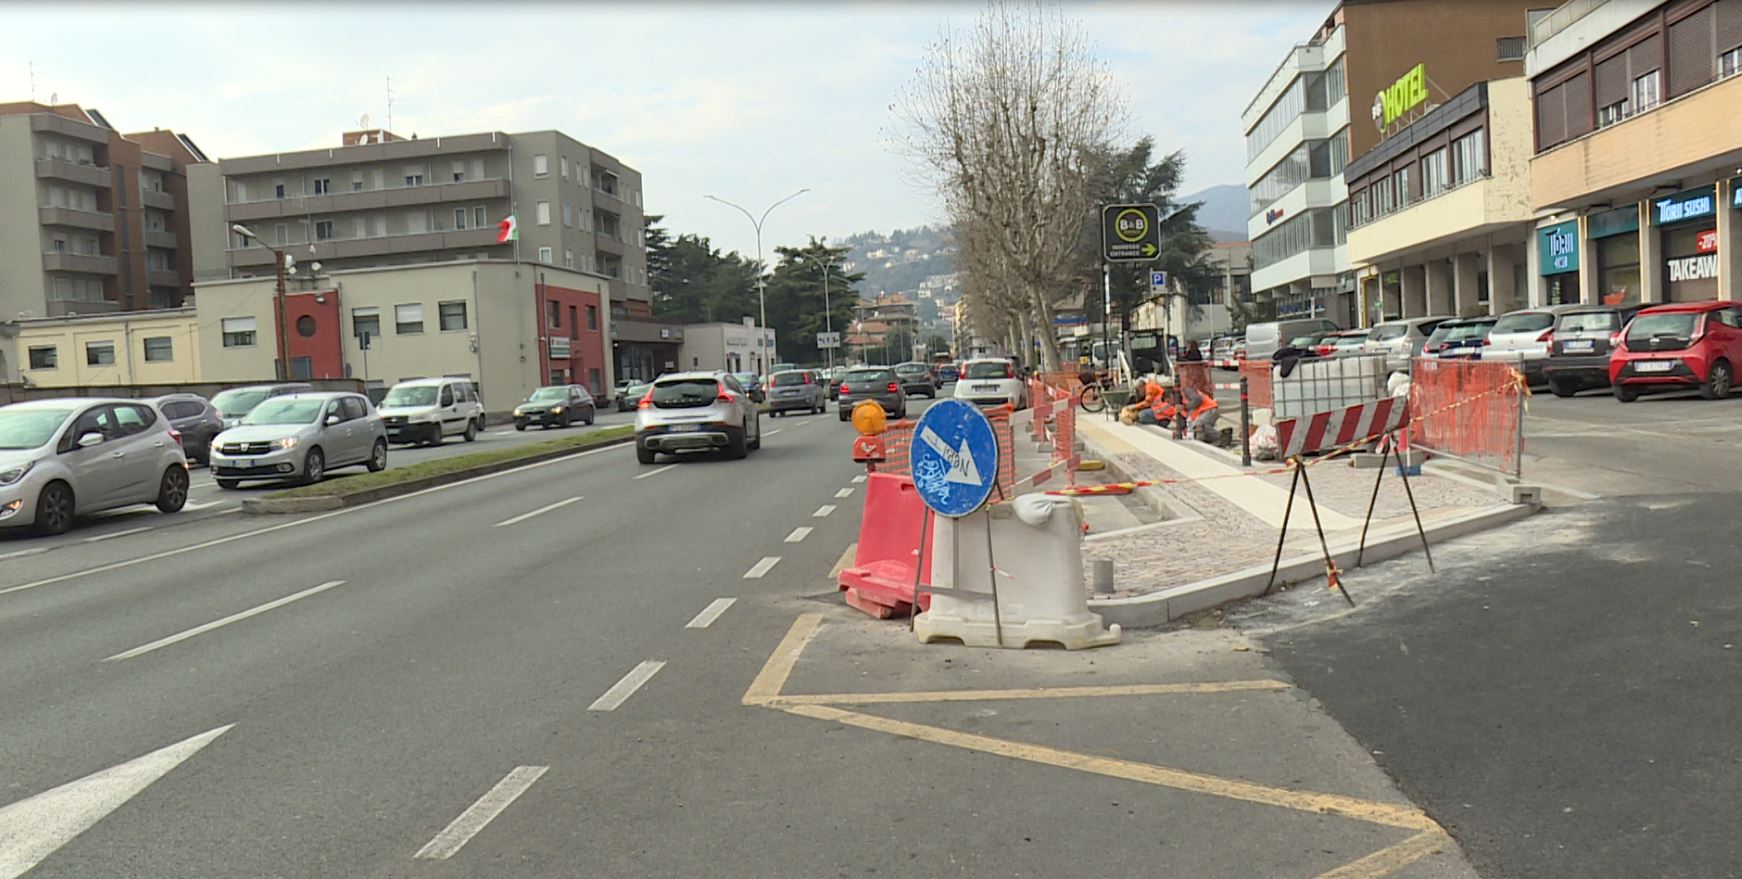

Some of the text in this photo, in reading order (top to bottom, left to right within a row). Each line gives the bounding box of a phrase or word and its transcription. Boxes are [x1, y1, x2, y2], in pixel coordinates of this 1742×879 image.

[1386, 63, 1428, 124] HOTEL
[1656, 196, 1710, 222] TORII SUSHI
[1154, 274, 1161, 285] P
[1668, 254, 1718, 281] TAKEAW
